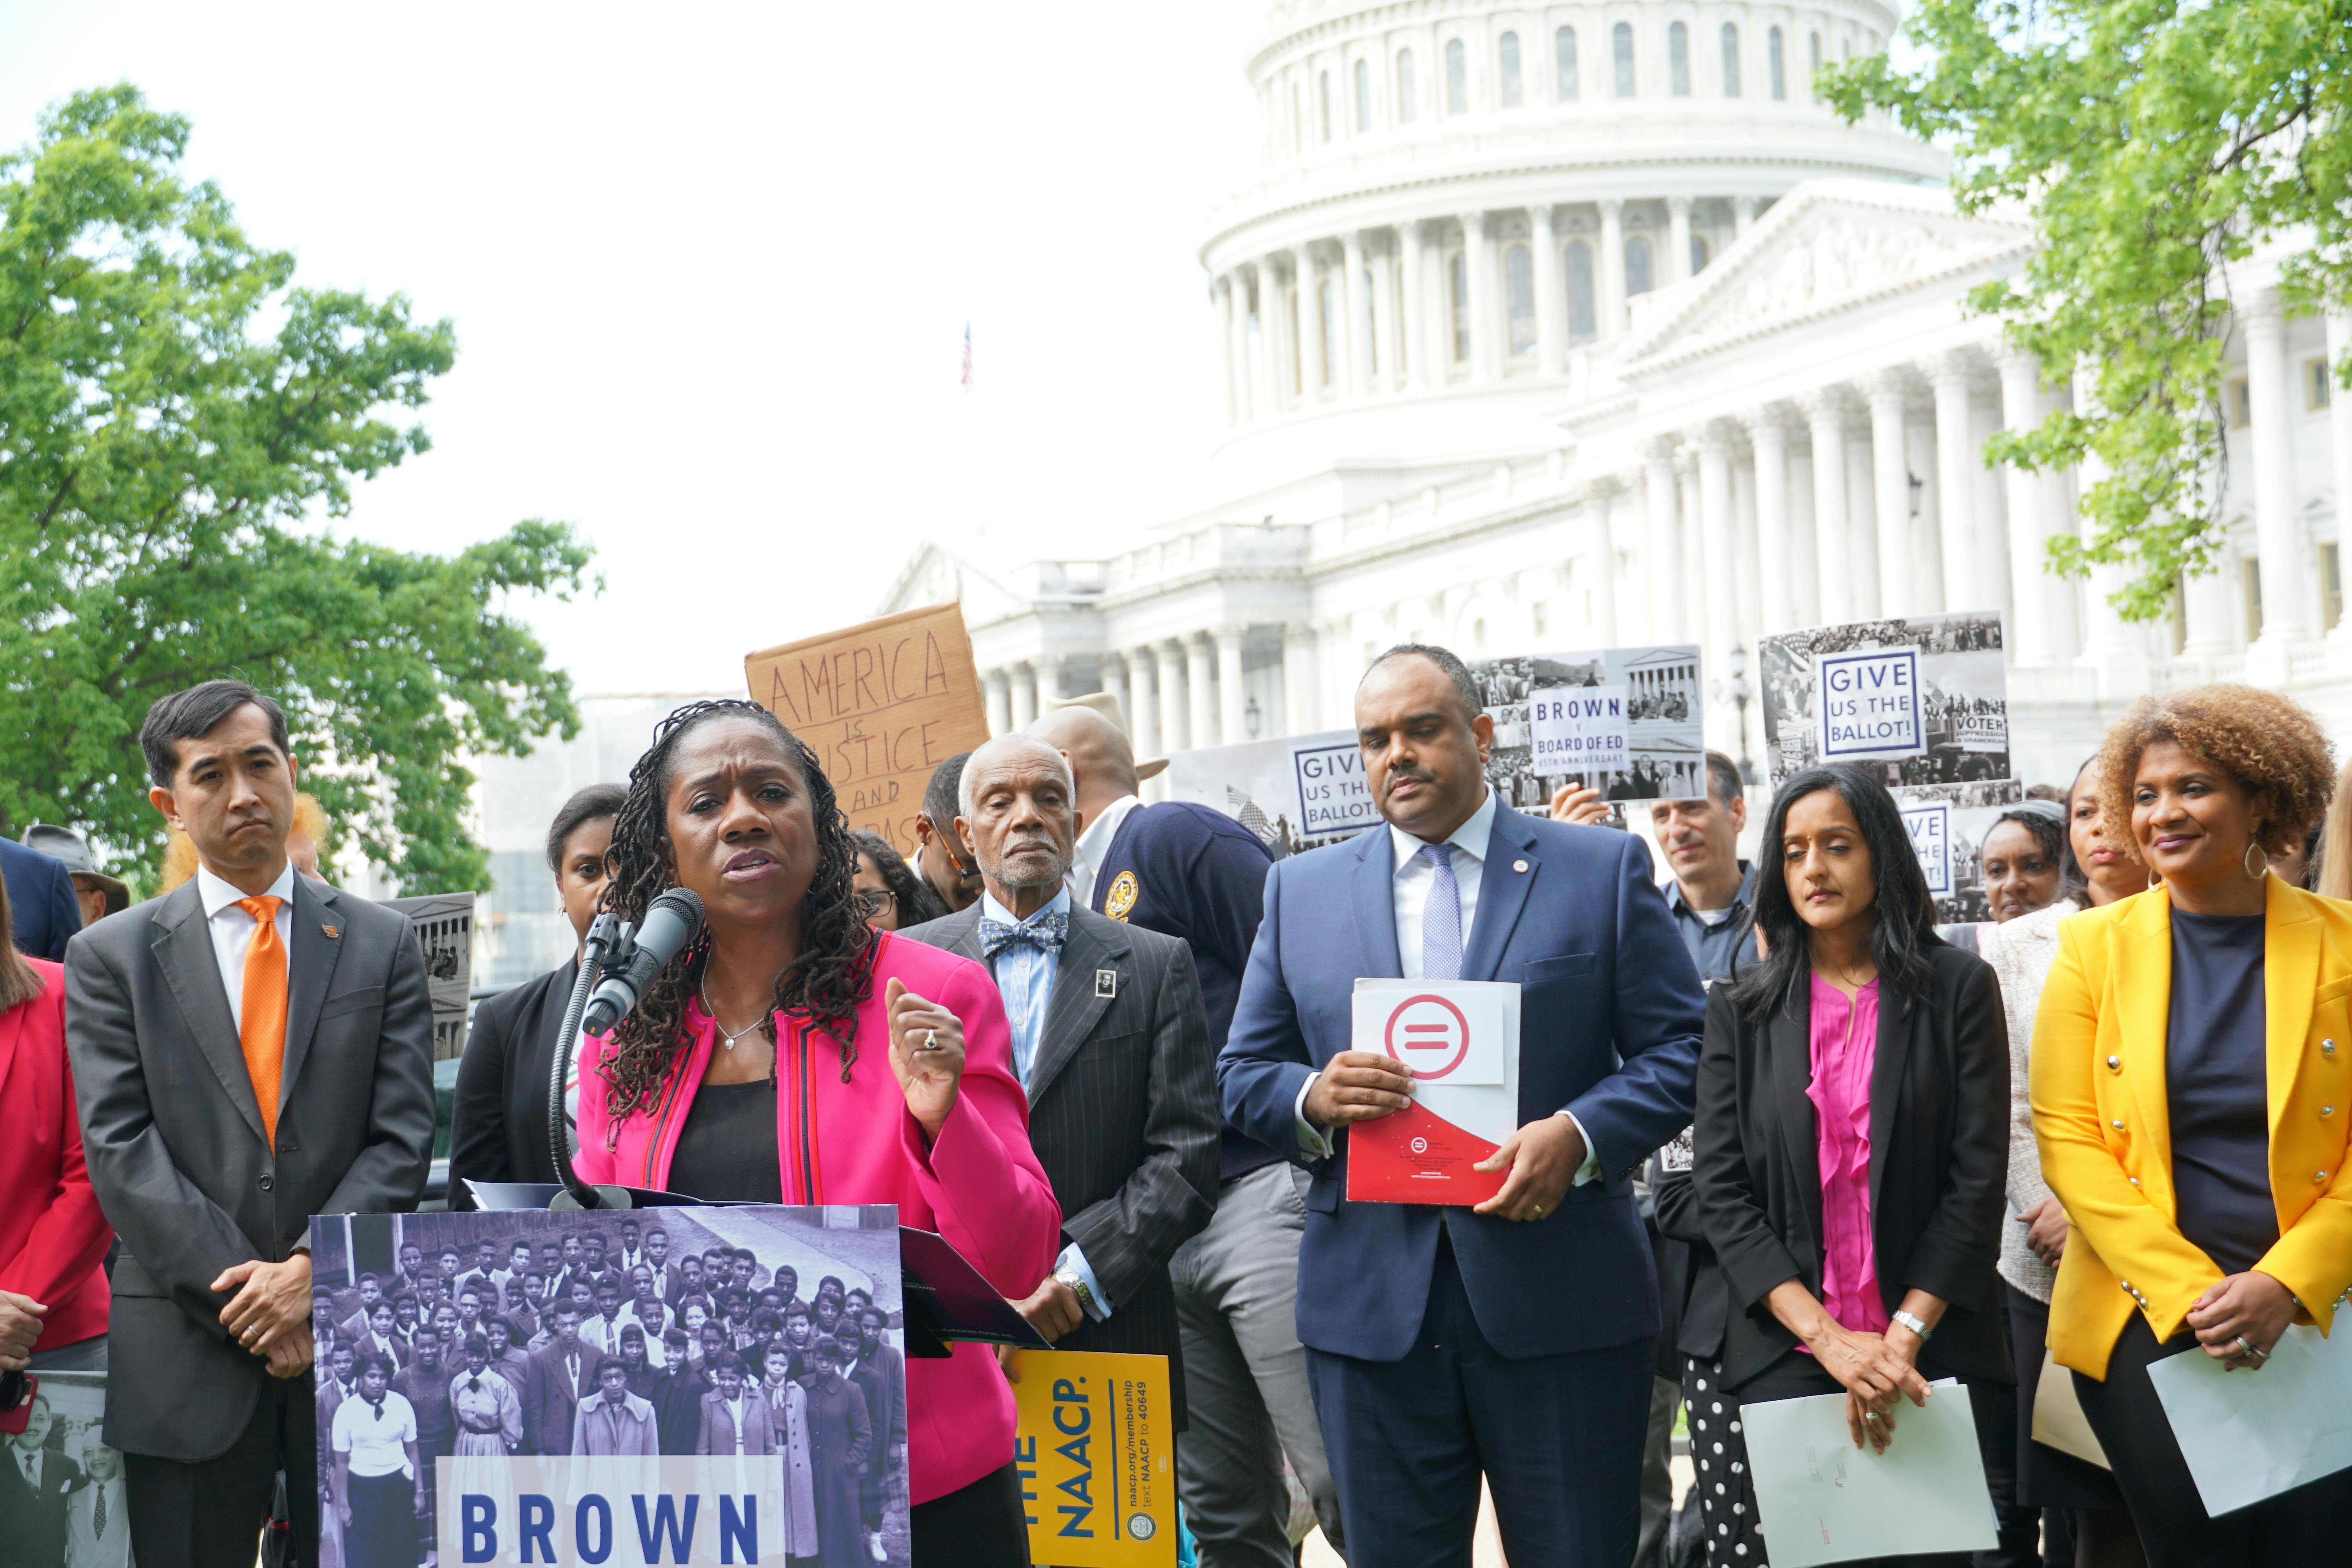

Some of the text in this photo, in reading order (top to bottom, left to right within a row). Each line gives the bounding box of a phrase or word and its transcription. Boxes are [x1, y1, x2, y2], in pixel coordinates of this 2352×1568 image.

[772, 630, 948, 723] AMERICA
[1830, 663, 1907, 691] GIVE
[1537, 698, 1620, 720] BROWN
[1831, 696, 1908, 717] US THE
[845, 719, 864, 741] IS
[1831, 720, 1910, 741] BALLOT!
[1957, 717, 2003, 730] VOTER
[813, 719, 943, 784] USTICE
[1538, 735, 1622, 753] BOARD OF ED
[1562, 754, 1623, 764] ANNIVERSARY
[852, 780, 899, 810] AND
[1306, 785, 1330, 800] US
[1908, 816, 1940, 837] VE
[1918, 845, 1940, 858] HE
[1123, 1380, 1138, 1506] naacp.org/membership
[1137, 1381, 1151, 1507] text NAACP to 40649
[1053, 1376, 1094, 1538] NAACP.
[461, 1493, 759, 1565] BROWN
